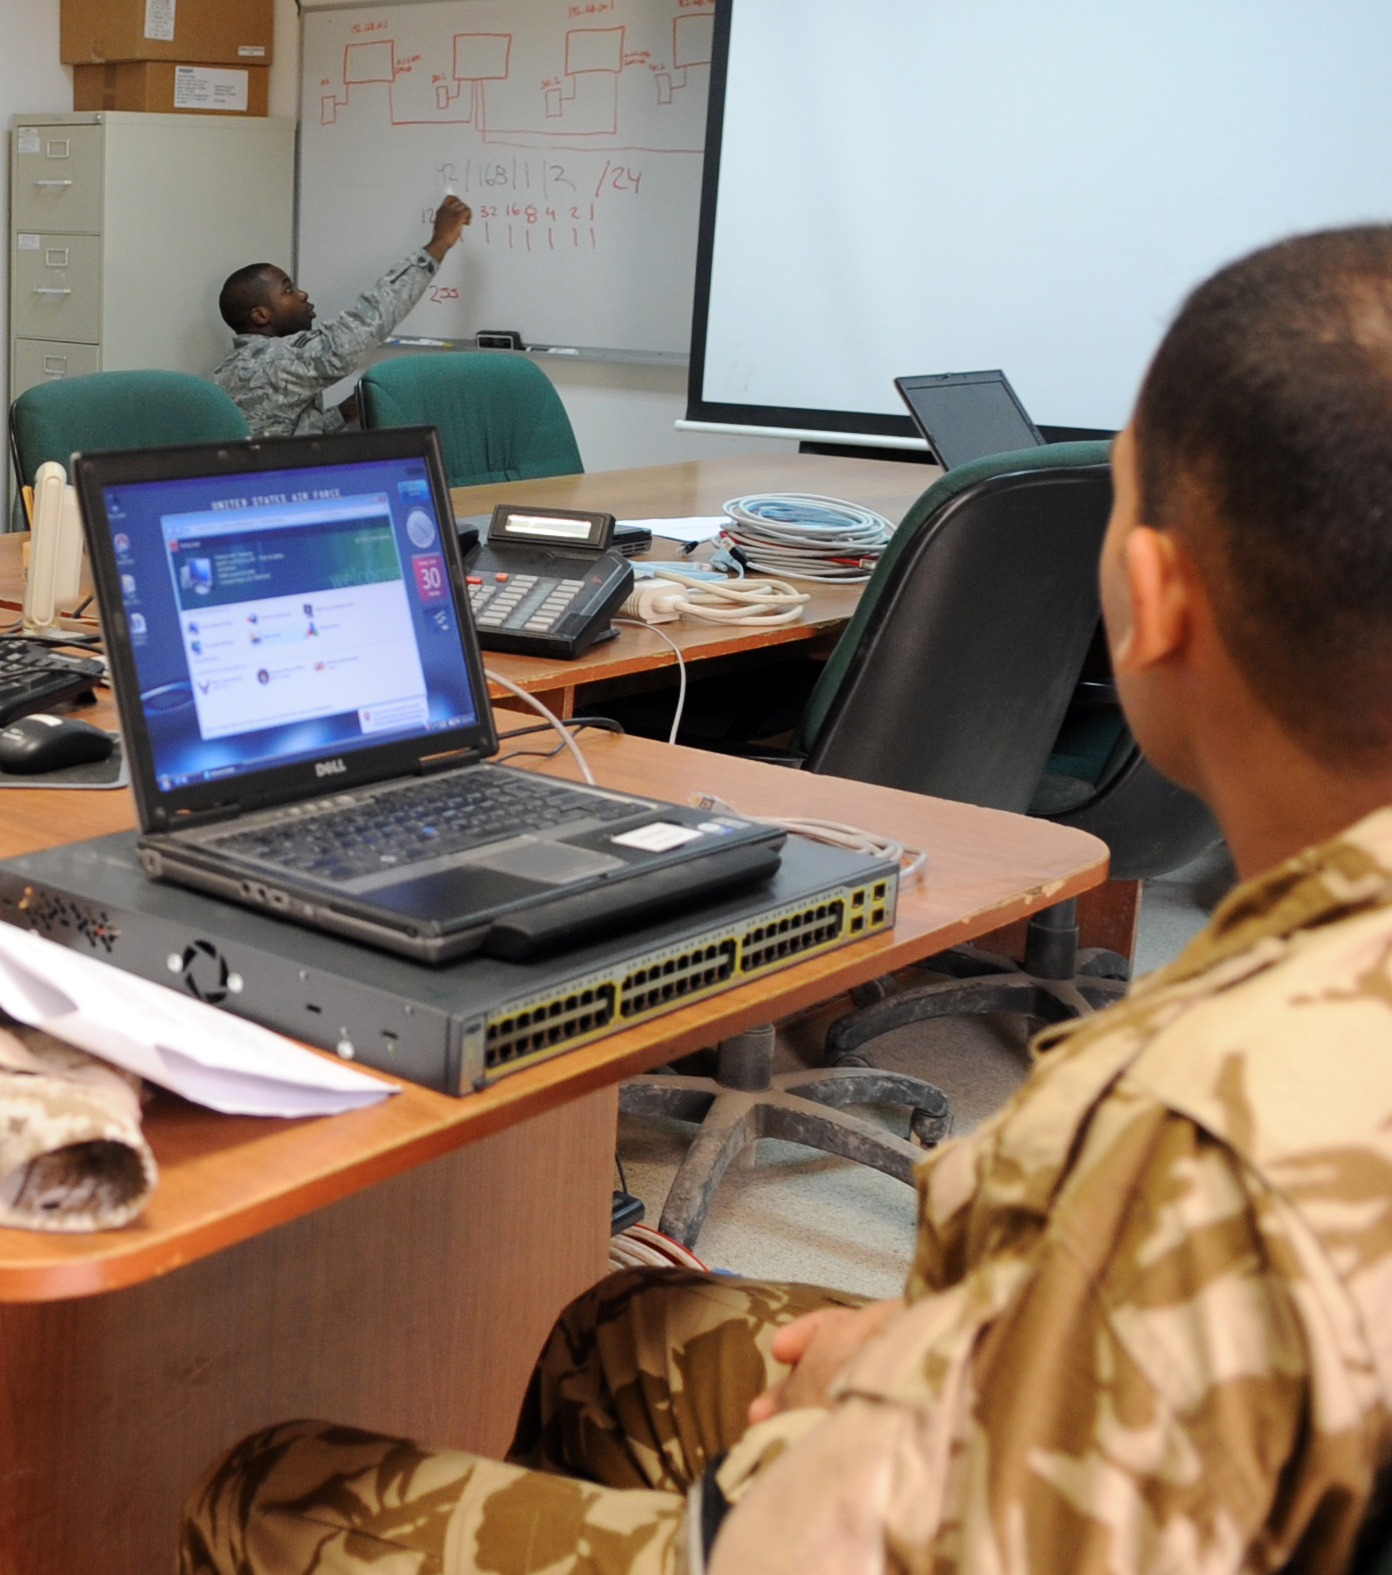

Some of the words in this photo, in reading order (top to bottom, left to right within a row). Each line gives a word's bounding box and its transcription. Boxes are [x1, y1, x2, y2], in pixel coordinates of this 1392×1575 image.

[480, 205, 498, 218] 32
[210, 497, 248, 511] UNITED
[252, 493, 287, 507] STATES
[291, 491, 309, 502] AIR
[313, 488, 341, 499] FORCE
[421, 566, 441, 590] 30
[315, 758, 347, 777] DELL
